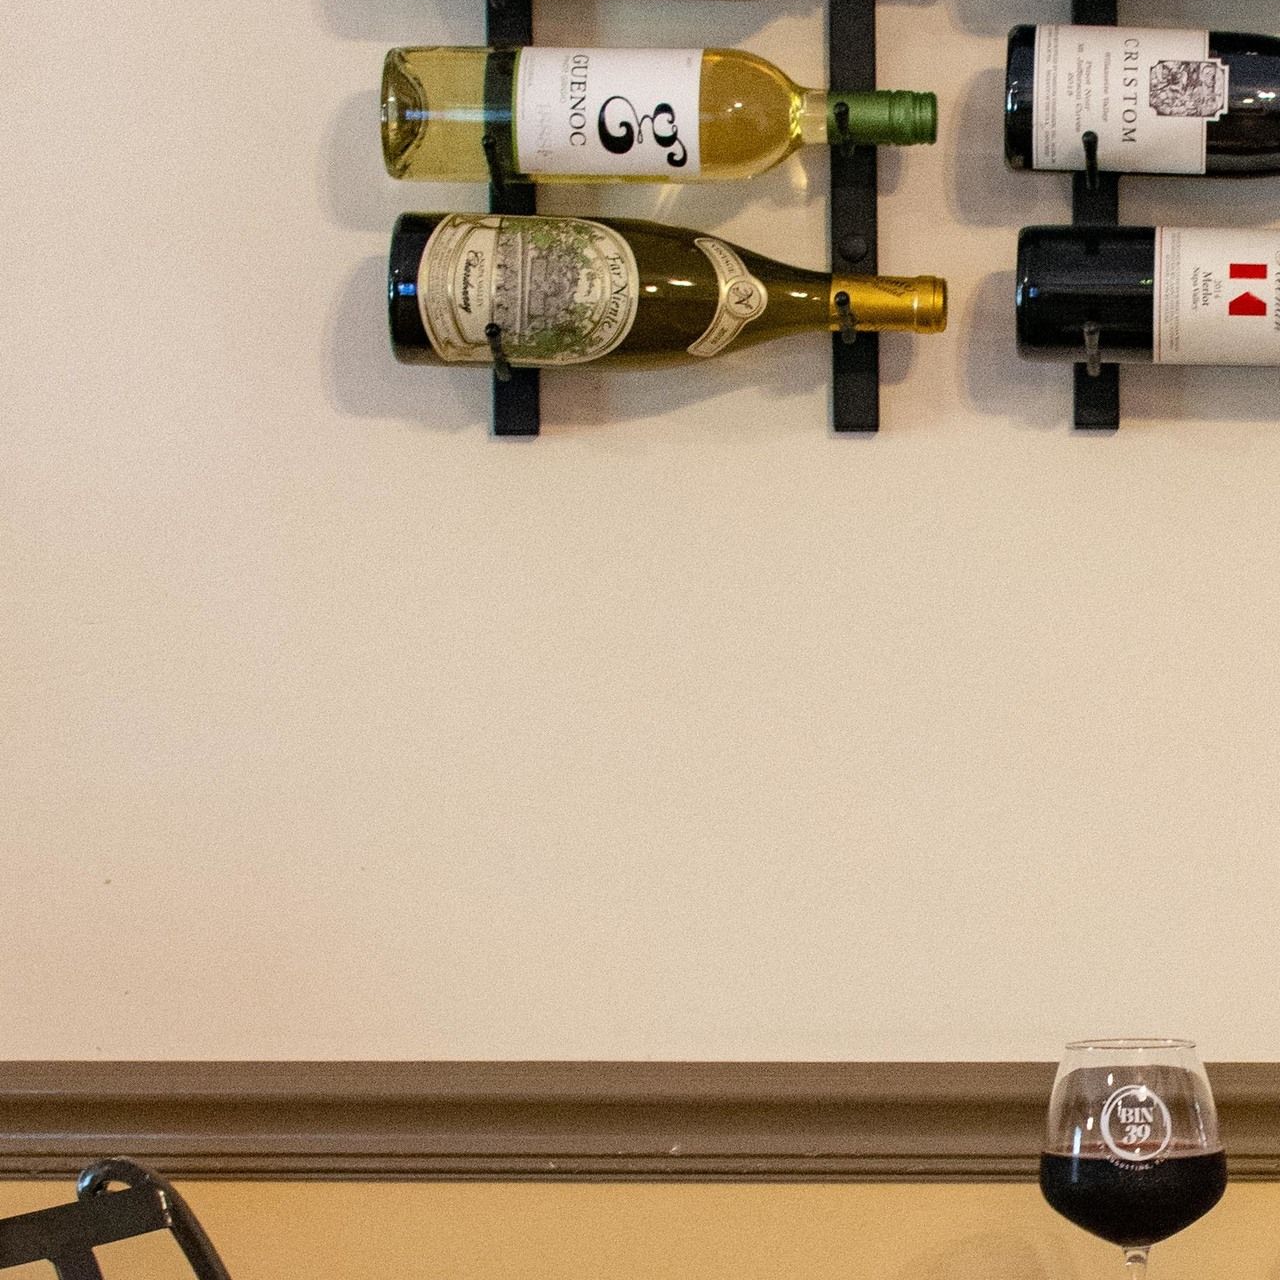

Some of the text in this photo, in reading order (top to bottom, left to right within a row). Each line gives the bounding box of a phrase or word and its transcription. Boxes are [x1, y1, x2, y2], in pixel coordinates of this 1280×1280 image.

[569, 54, 590, 148] GUENOC
[1121, 38, 1140, 144] CRISTOM
[460, 249, 485, 315] Chardonnay
[602, 252, 628, 331] Far Niente
[1190, 266, 1201, 312] Napa Valley
[1201, 271, 1213, 307] Merlot
[1120, 1106, 1154, 1124] BIN
[1122, 1124, 1151, 1145] 39
